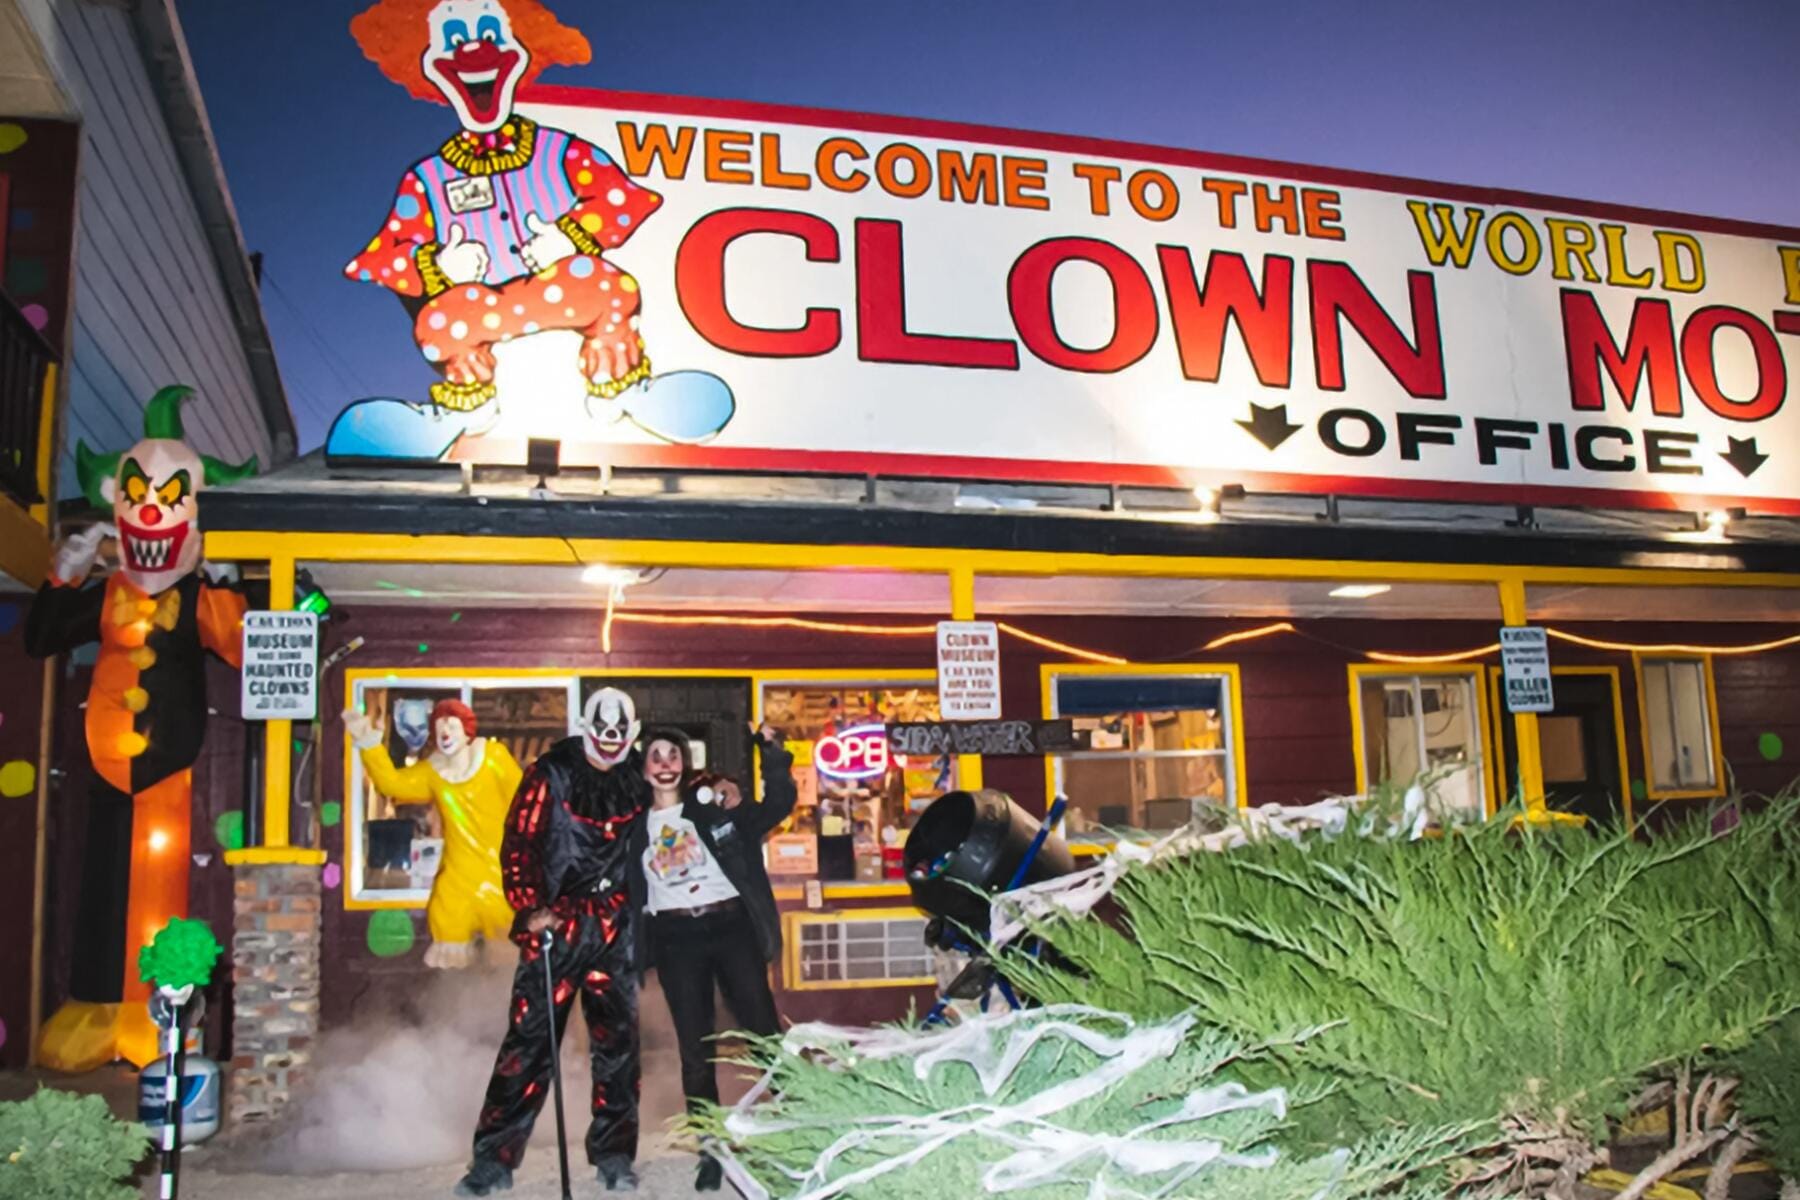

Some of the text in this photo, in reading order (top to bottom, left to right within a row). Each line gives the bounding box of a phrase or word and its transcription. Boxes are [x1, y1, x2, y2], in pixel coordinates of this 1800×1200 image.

[616, 121, 1050, 210] WELCOME
[1073, 163, 1180, 222] TO
[1202, 176, 1346, 241] THE
[1406, 200, 1706, 293] WORLD
[675, 206, 1800, 422] CLOWN MO
[1317, 407, 1703, 476] OFFICE
[246, 617, 312, 628] CAUTION
[246, 634, 313, 649] MUSEUM
[946, 633, 989, 647] CLOWN
[941, 649, 996, 661] MUSEUM
[245, 663, 313, 678] HAUNTED
[249, 680, 309, 695] CLOWNS
[816, 736, 887, 768] OPE
